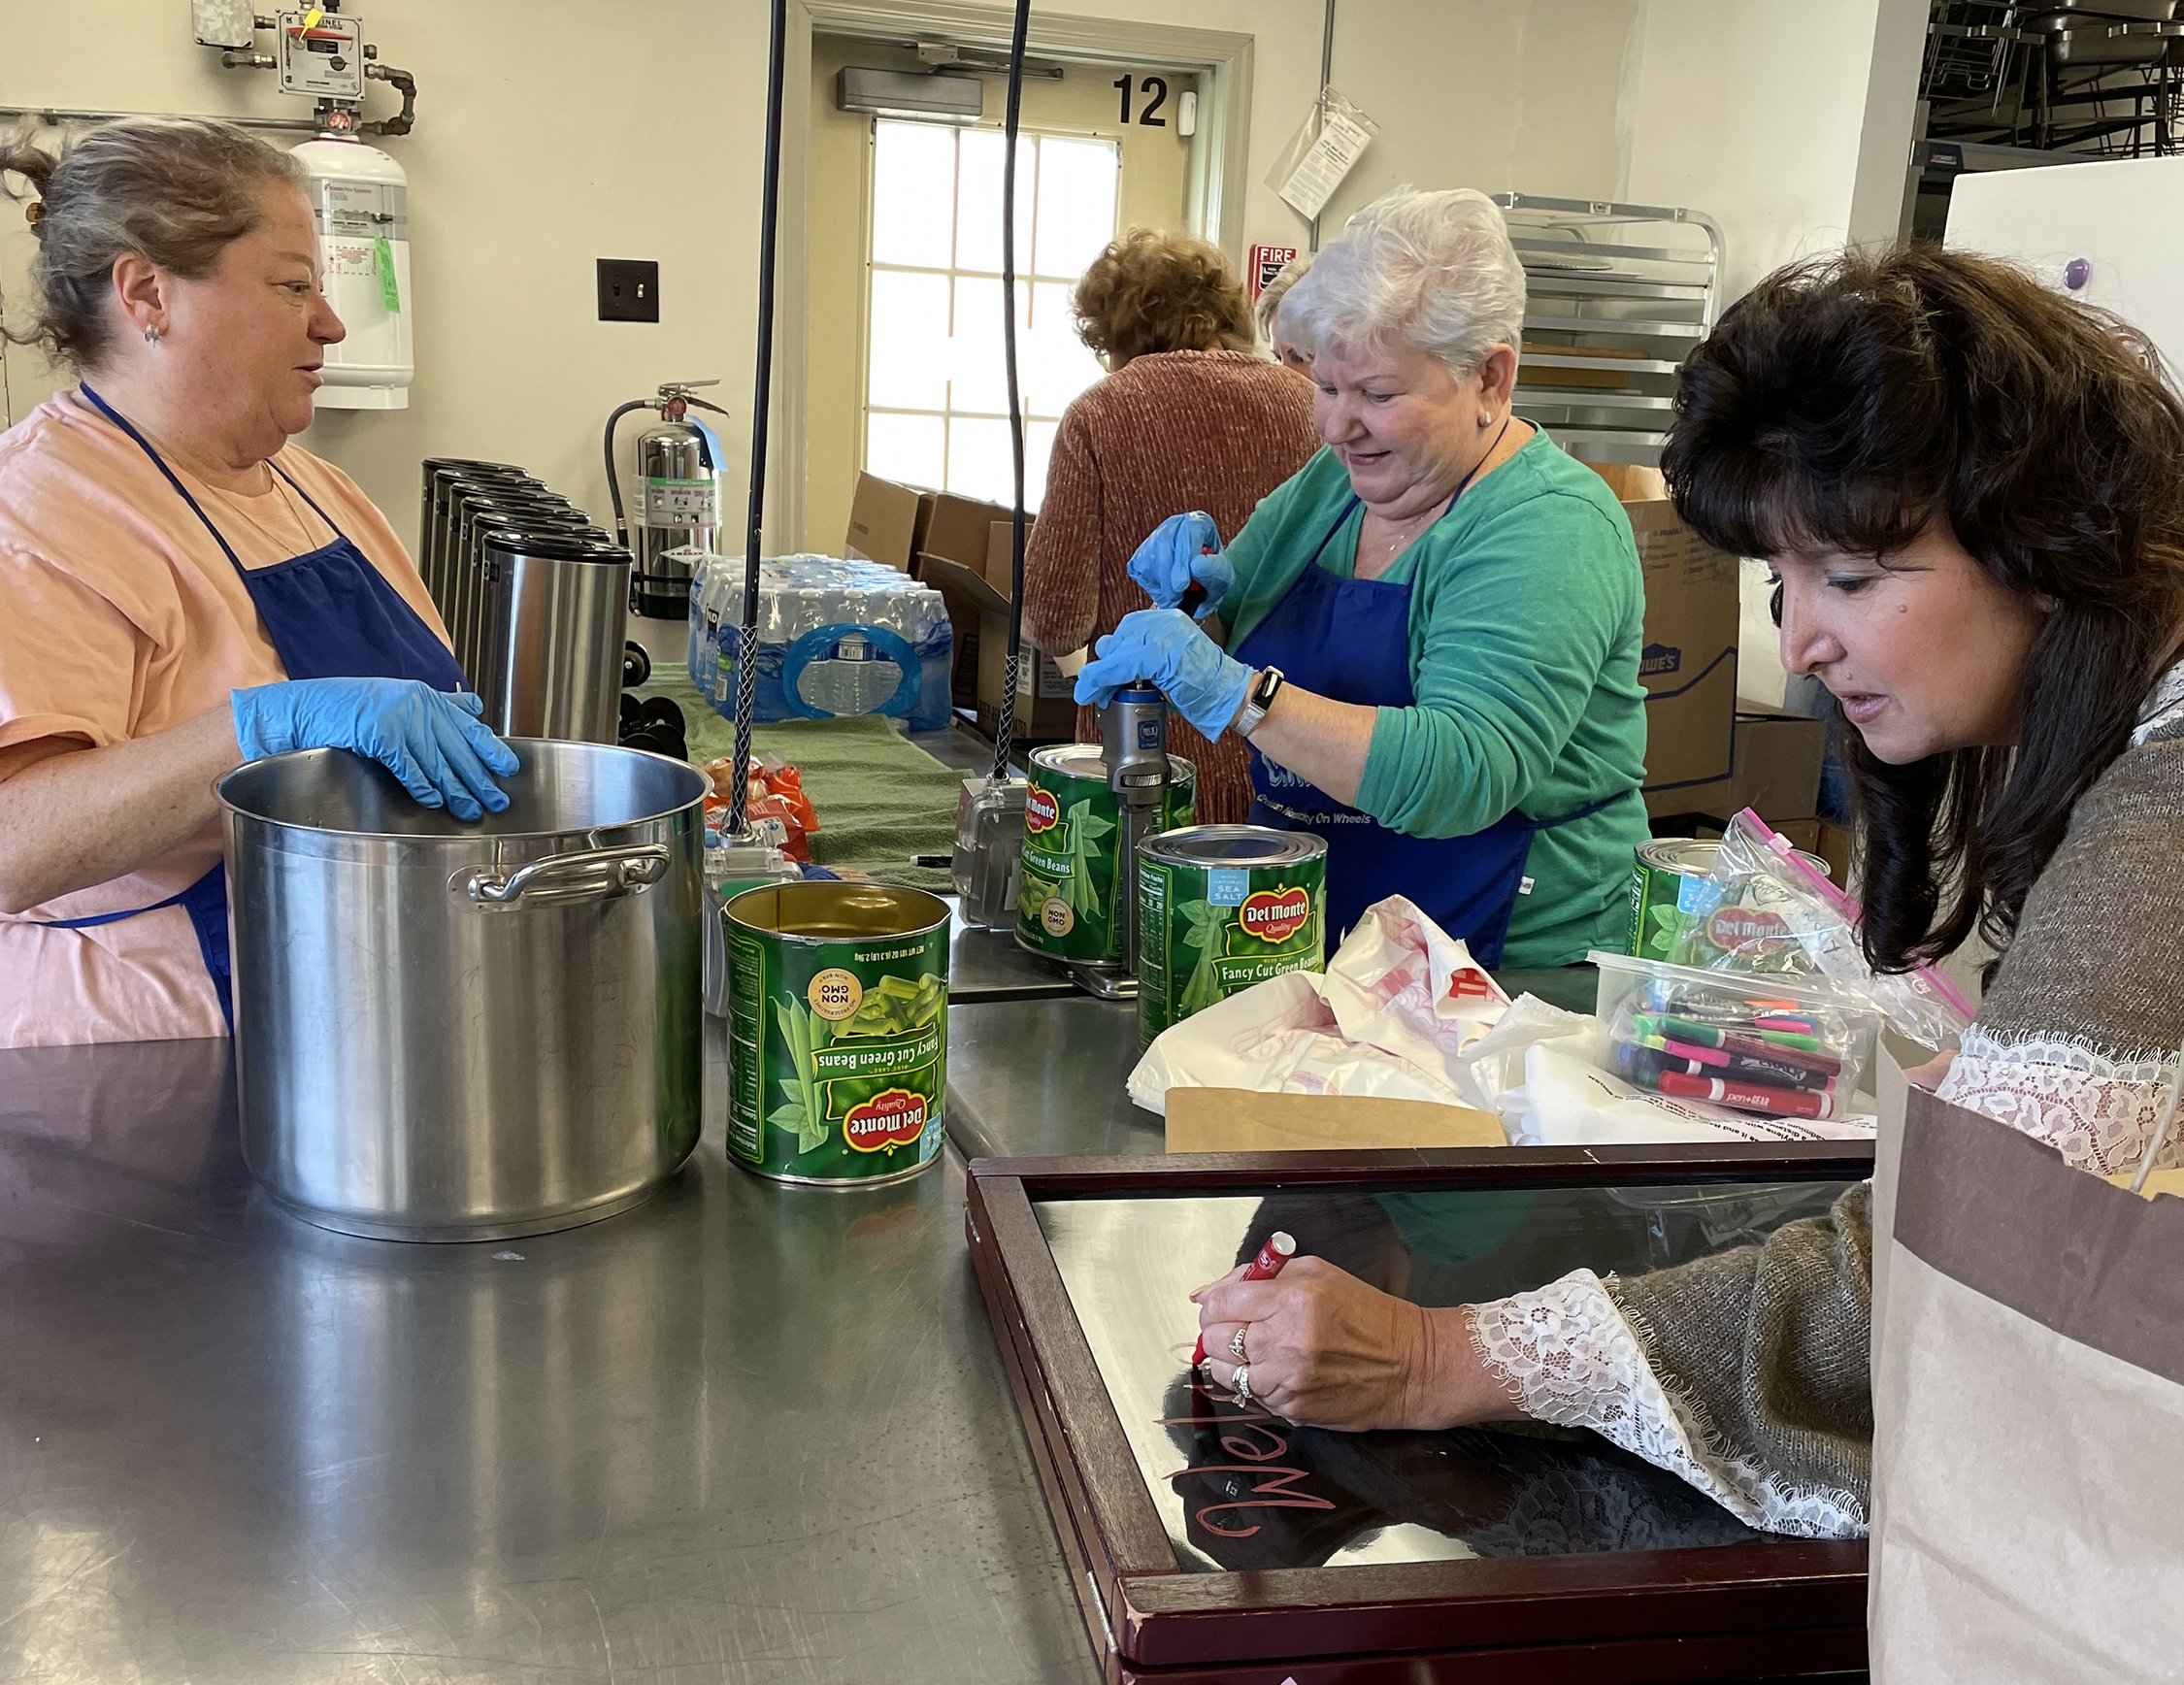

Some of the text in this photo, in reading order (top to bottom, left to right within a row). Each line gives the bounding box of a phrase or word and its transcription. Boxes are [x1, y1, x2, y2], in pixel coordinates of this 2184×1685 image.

[1112, 75, 1168, 127] 12
[1260, 248, 1293, 263] FIRE
[1032, 800, 1056, 819] Monte
[1315, 812, 1372, 824] On Wheels
[1030, 851, 1046, 869] Green
[1046, 858, 1071, 874] Beans
[1048, 909, 1065, 919] NON
[1246, 901, 1306, 922] Del Monte
[1047, 916, 1065, 926] GMO
[1266, 922, 1293, 935] Quality
[1715, 919, 1788, 937] Del Monte
[871, 952, 879, 961] LB)
[892, 950, 899, 959] OZ
[1222, 954, 1318, 982] Fancy Cut Green Beans
[821, 985, 849, 994] GMO
[821, 995, 848, 1004] NON
[818, 1038, 939, 1074] Fancy Cut Green Beans
[875, 1099, 906, 1112] Quality
[850, 1107, 923, 1137] Del Monte
[1722, 1126, 1739, 1136] and
